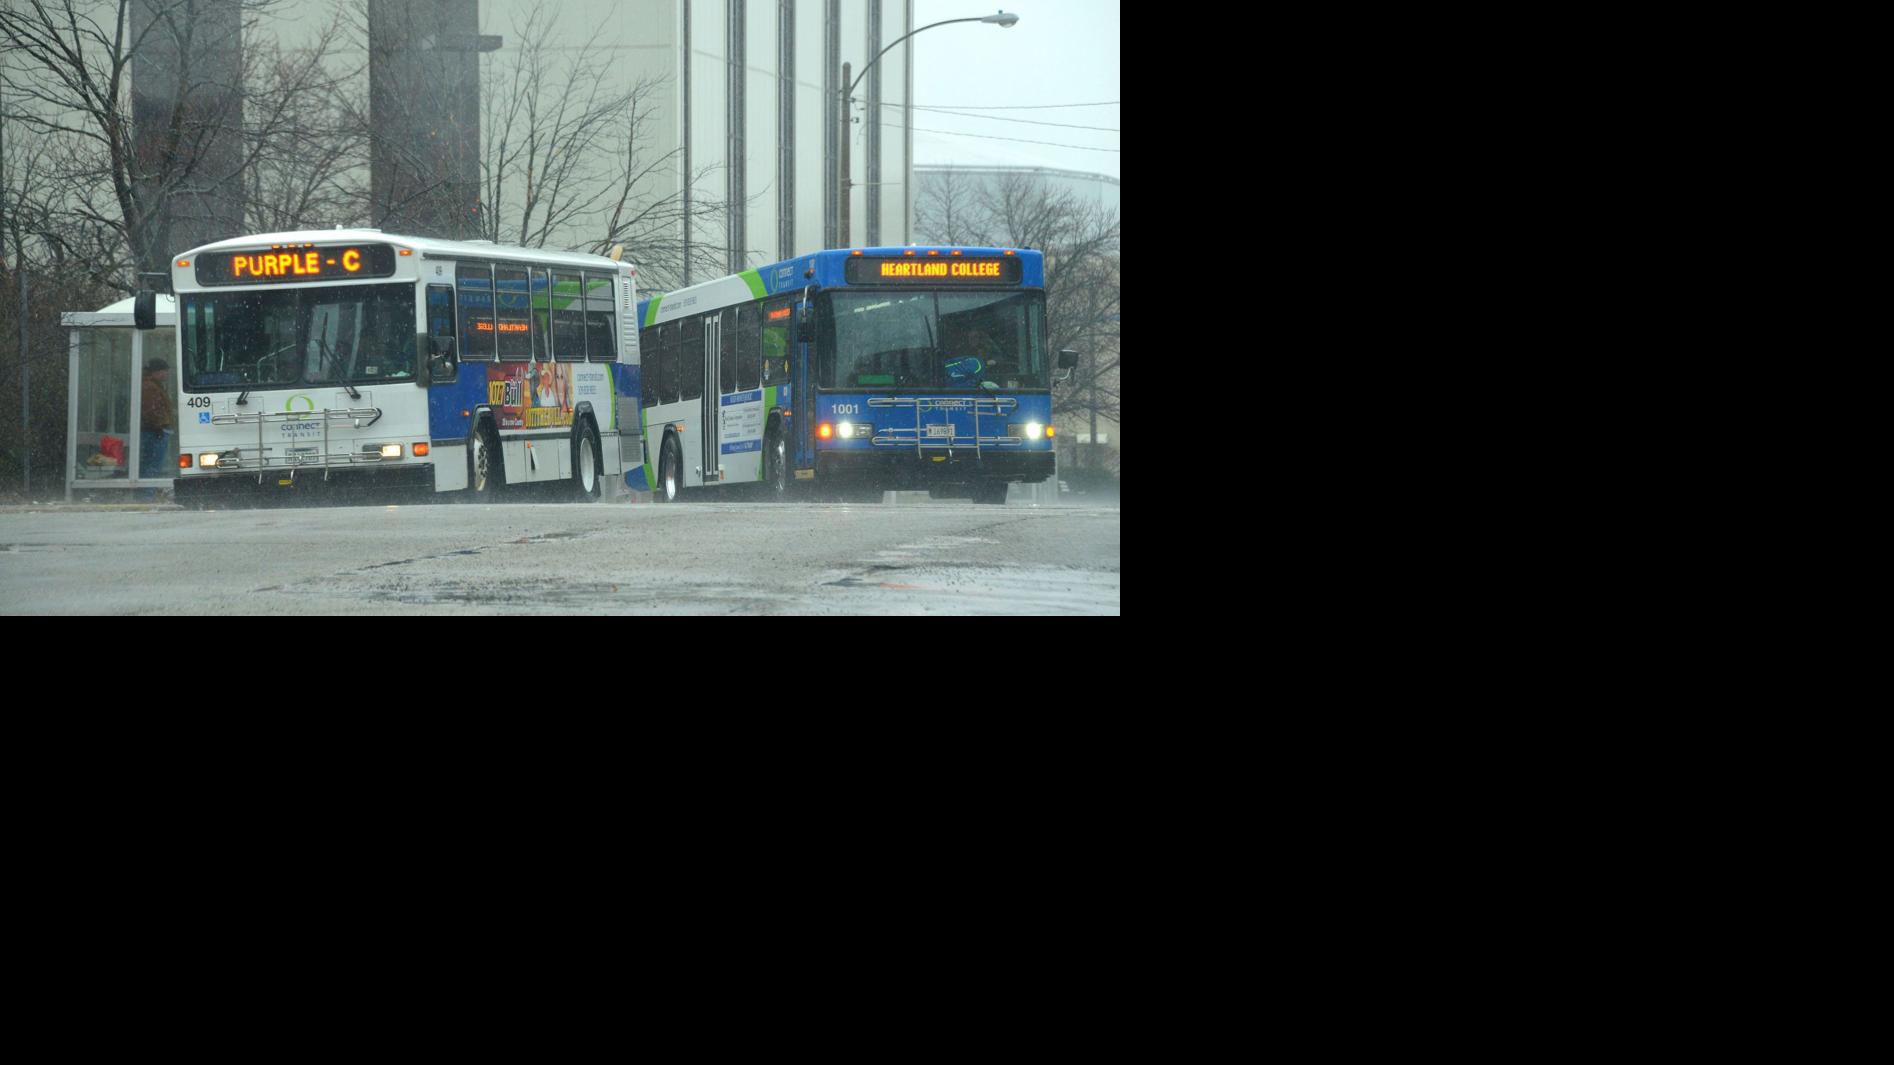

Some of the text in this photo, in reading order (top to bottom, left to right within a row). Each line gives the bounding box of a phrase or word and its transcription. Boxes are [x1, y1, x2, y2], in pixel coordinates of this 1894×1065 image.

[233, 252, 320, 276] PURPLE
[342, 249, 361, 272] C
[881, 262, 1000, 276] HEARTLAND COLLEGE
[187, 397, 211, 408] 409
[832, 404, 859, 414] 1001
